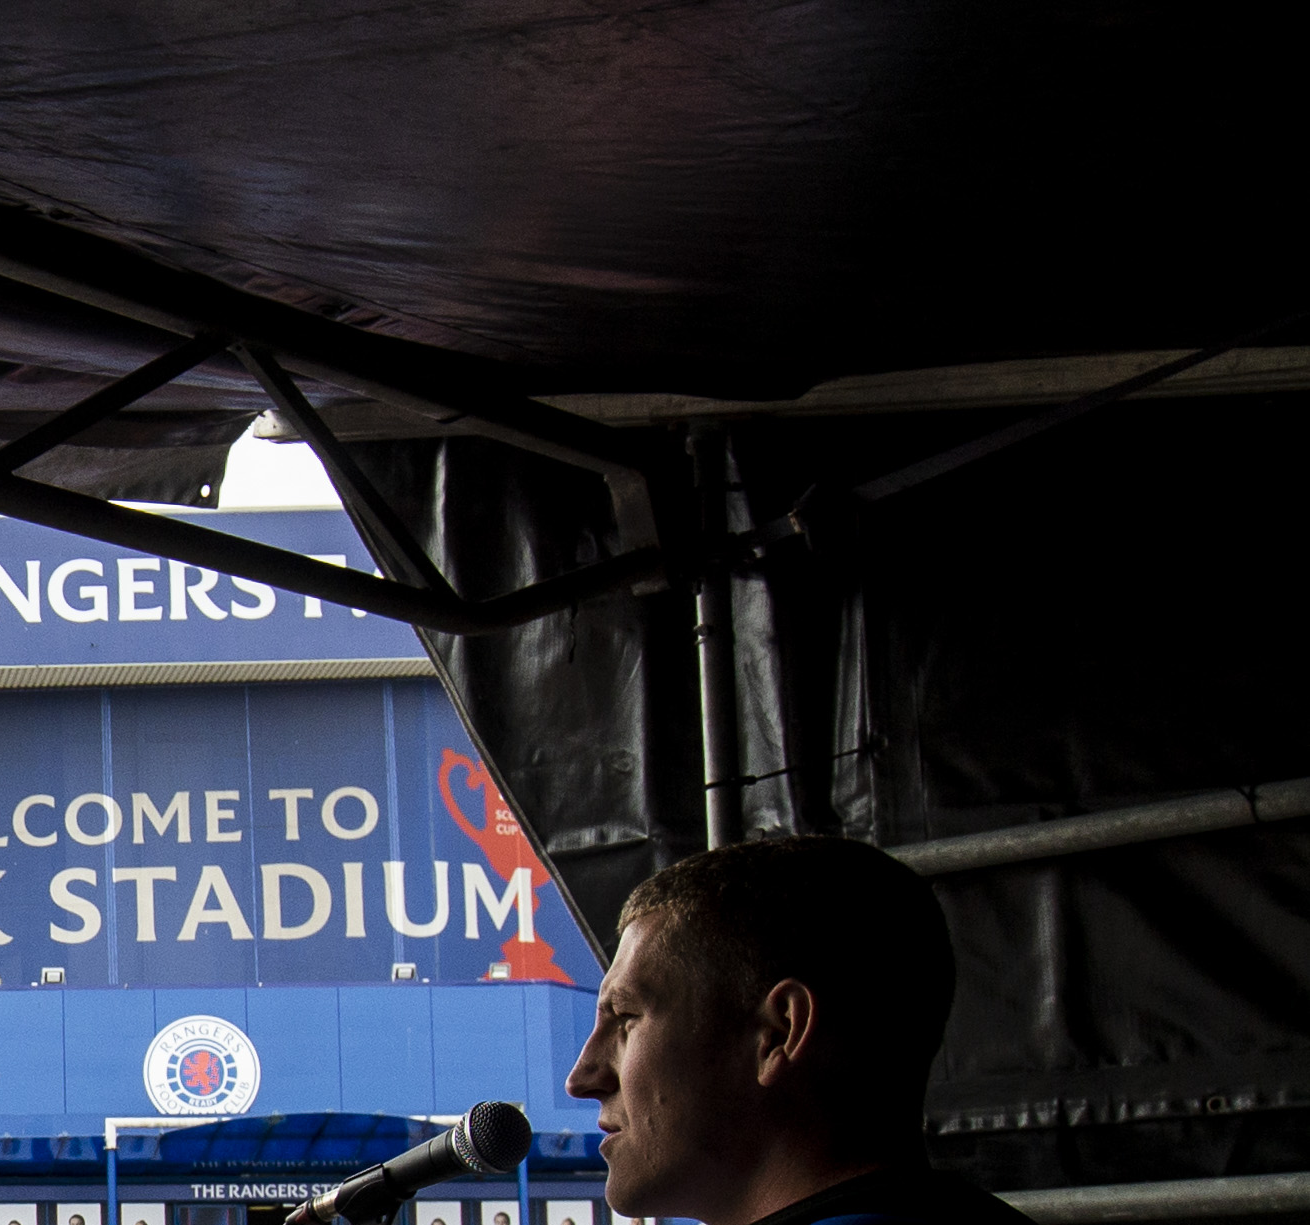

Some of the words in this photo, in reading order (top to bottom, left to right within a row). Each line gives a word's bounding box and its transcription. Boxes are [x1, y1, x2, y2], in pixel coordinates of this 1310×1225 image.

[268, 786, 379, 840] TO
[49, 860, 536, 944] STADIUM
[159, 1023, 244, 1053] RANGERS
[191, 1183, 225, 1199] THE
[229, 1183, 309, 1199] RANGERS
